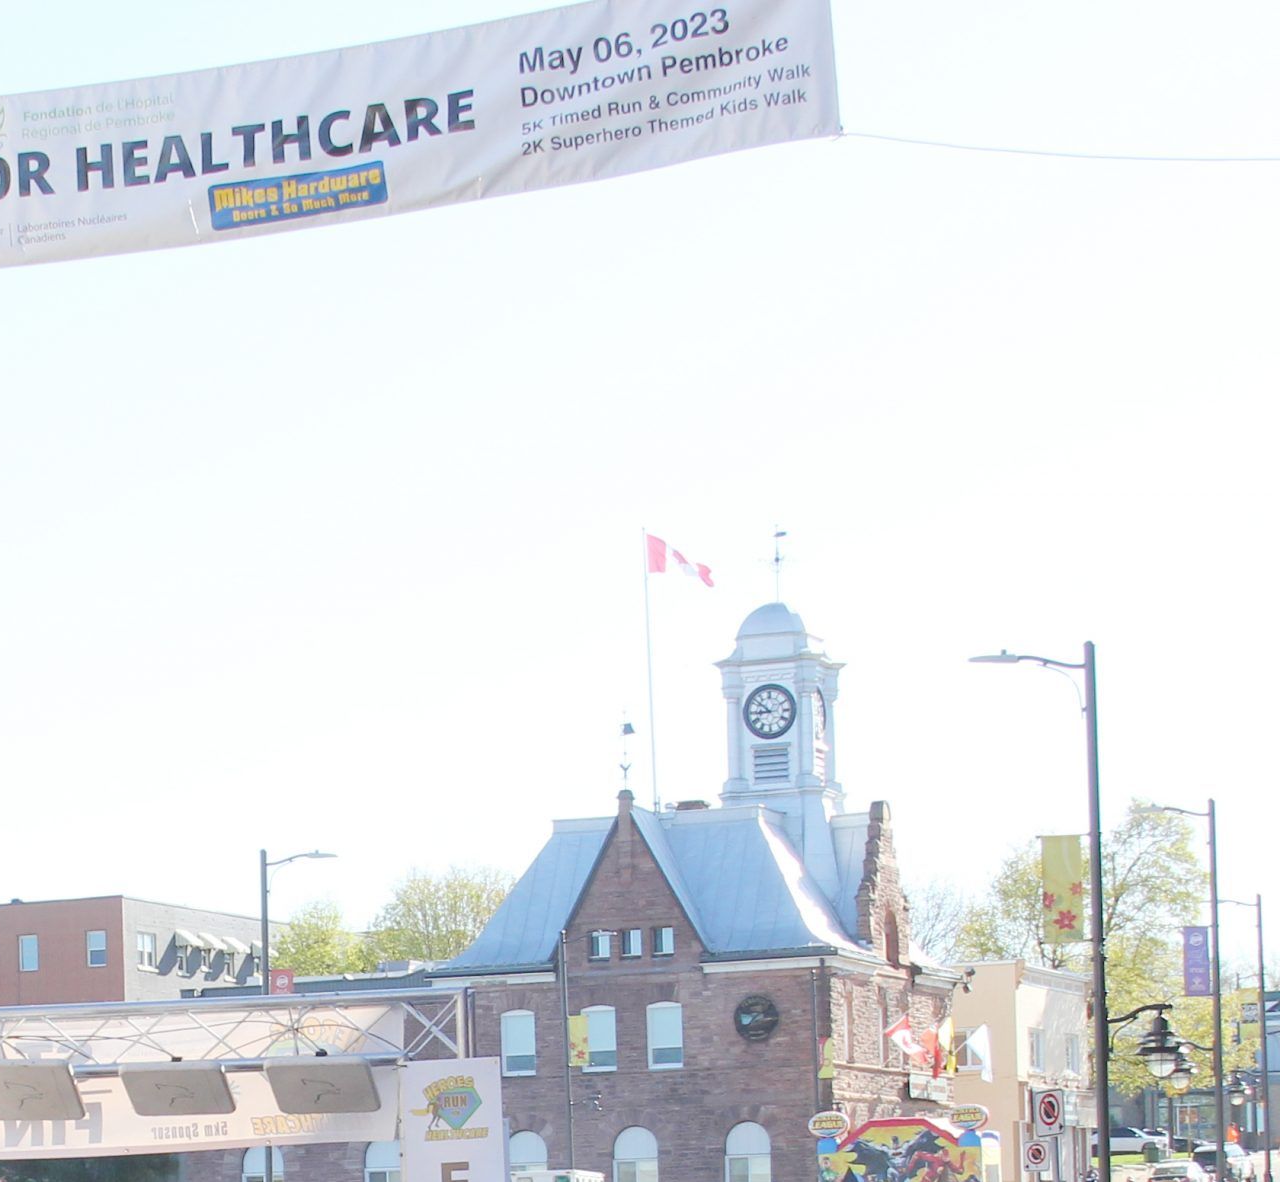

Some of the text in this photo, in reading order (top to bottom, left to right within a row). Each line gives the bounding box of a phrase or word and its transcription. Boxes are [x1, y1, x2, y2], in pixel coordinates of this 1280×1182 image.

[518, 8, 730, 74] May 06, 2023
[520, 36, 789, 108] Downtown Pembroke
[23, 106, 92, 122] Fondation
[96, 101, 114, 113] de
[521, 64, 811, 136] 5K Timed Run & Community Walk
[84, 119, 102, 132] de
[106, 110, 175, 127] Pembroke
[521, 89, 807, 157] 2K Superhero Themed Kids Walk
[75, 89, 477, 192] HEALTHCARE
[214, 168, 381, 212] Mikes Hardware
[303, 197, 335, 211] Much
[339, 191, 369, 204] More
[17, 219, 75, 233] Laboratoires
[17, 232, 66, 245] Canadiens
[444, 1096, 467, 1107] RUN
